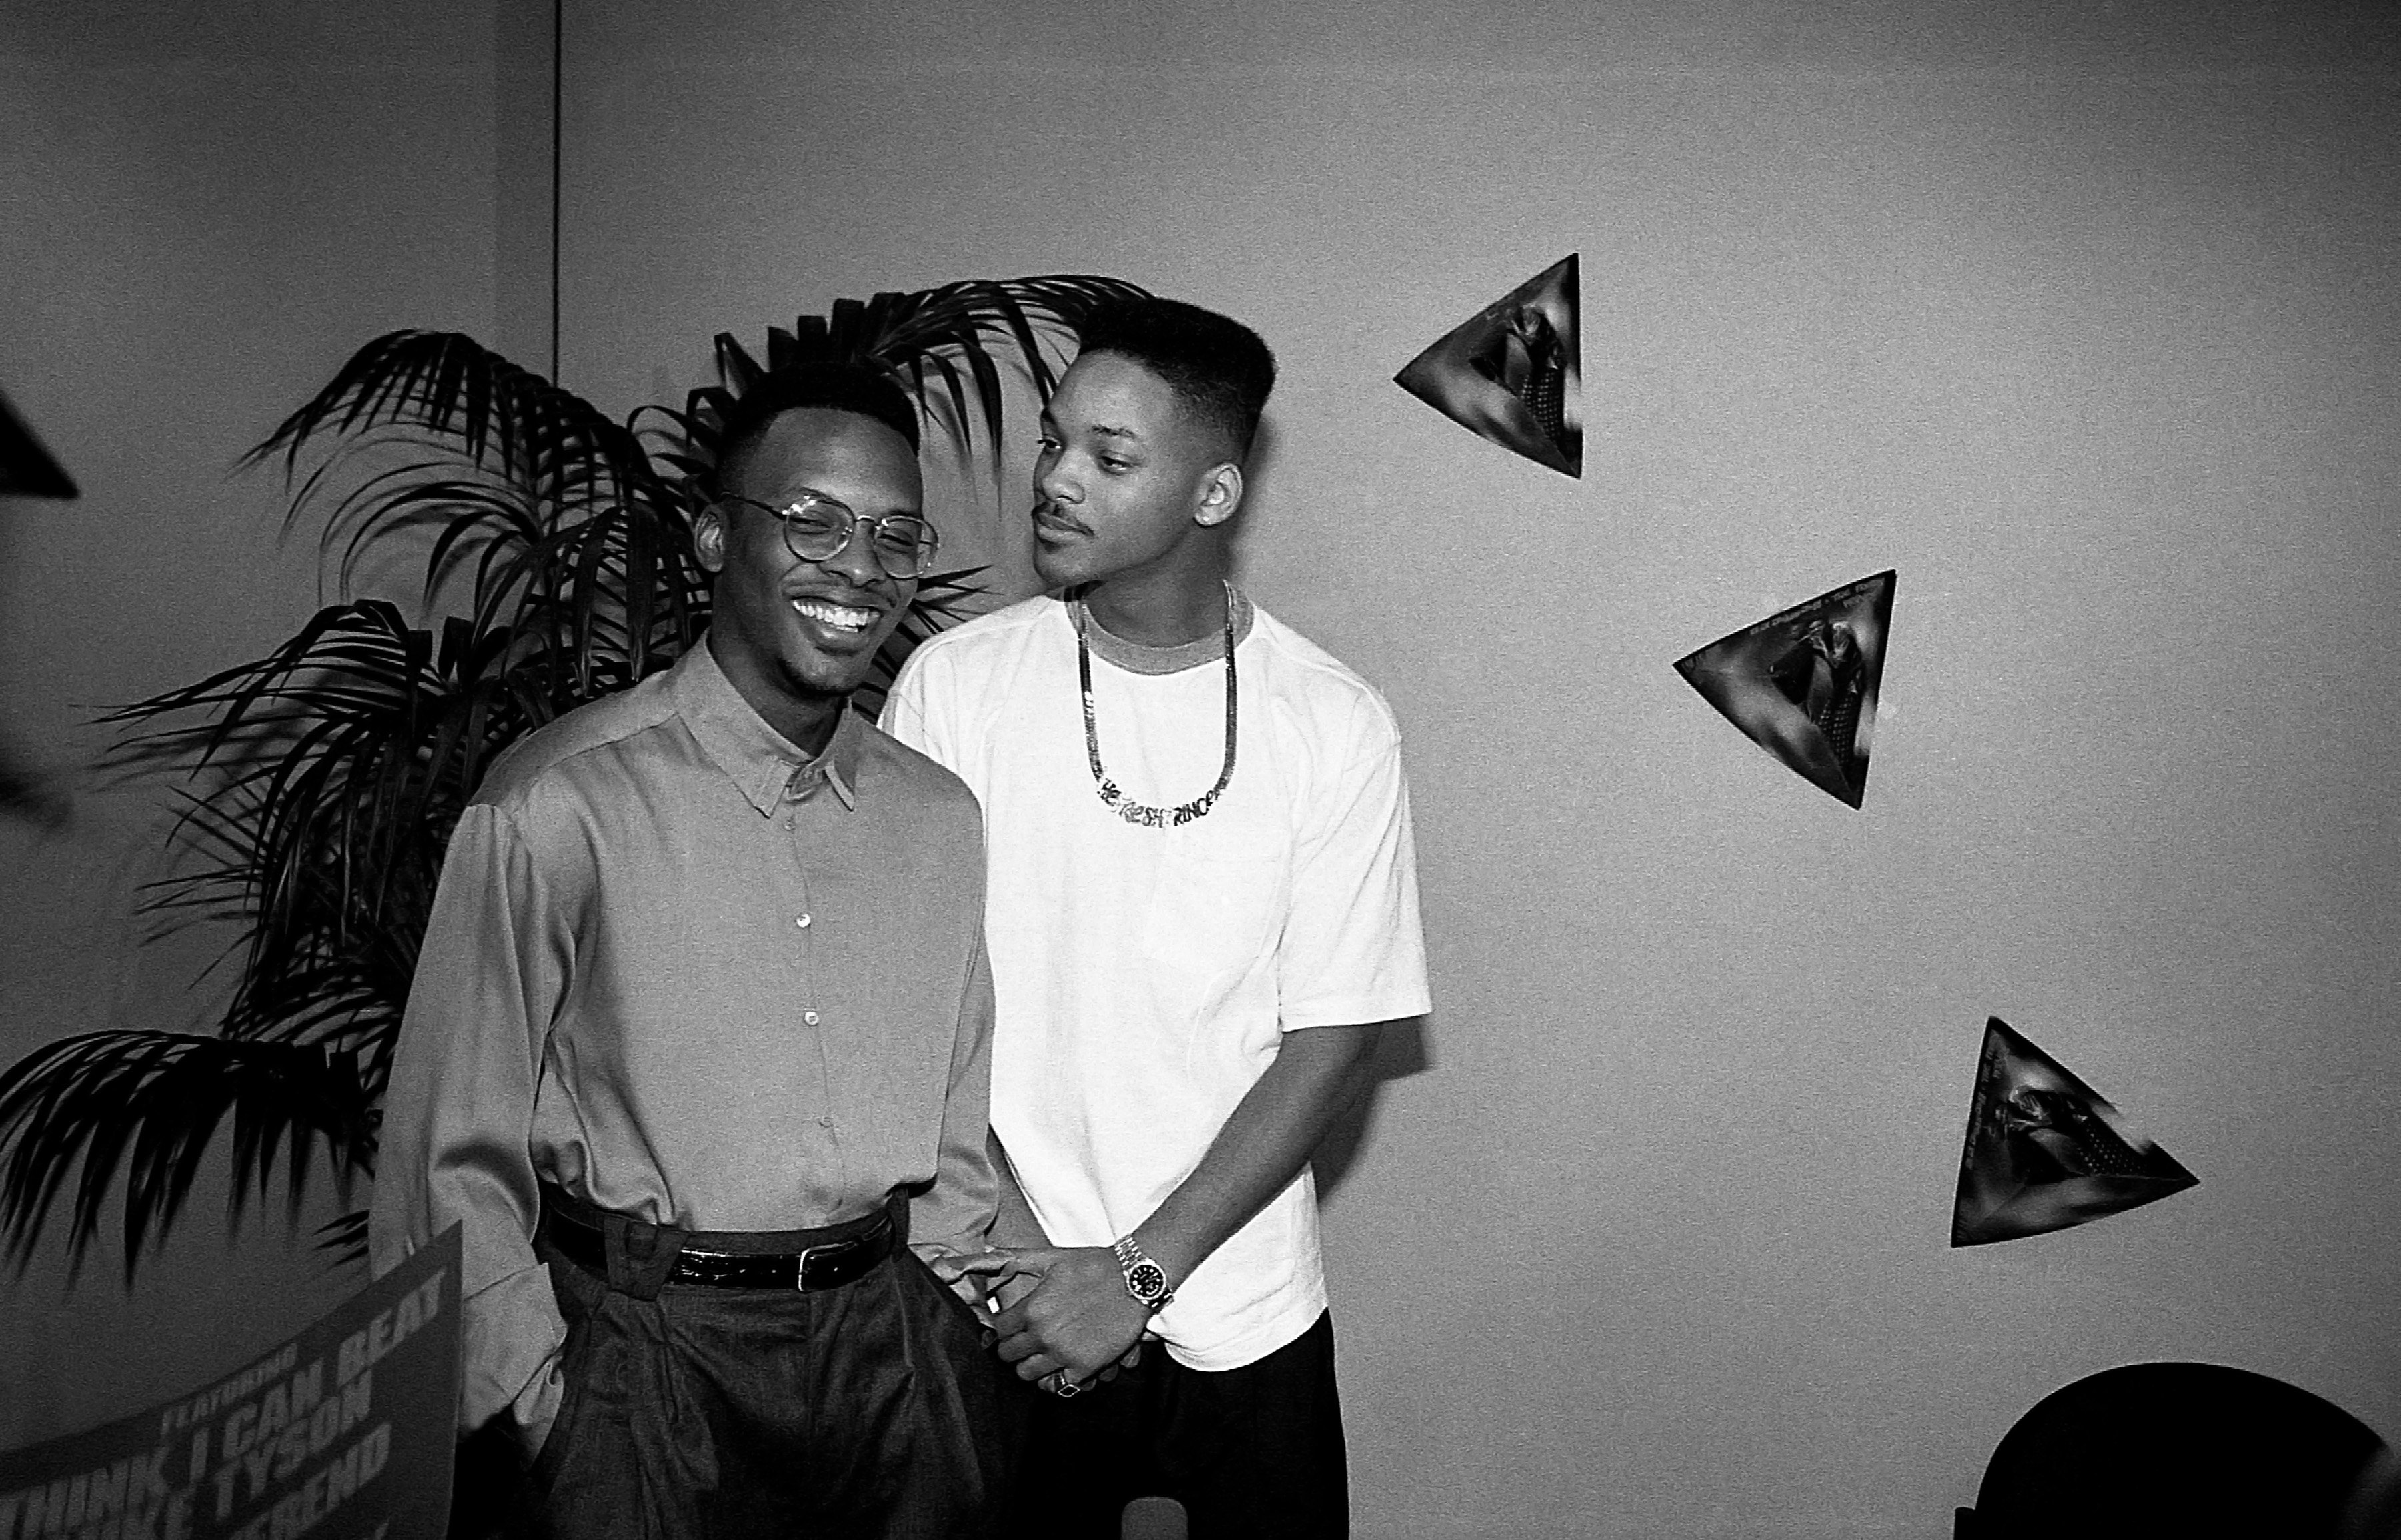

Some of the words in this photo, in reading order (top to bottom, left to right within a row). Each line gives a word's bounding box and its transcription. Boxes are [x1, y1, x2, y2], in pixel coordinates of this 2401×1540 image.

[189, 1428, 209, 1481] I
[223, 1357, 324, 1459] CAN
[337, 1269, 446, 1387] BEAT
[214, 1366, 372, 1521] TYSON
